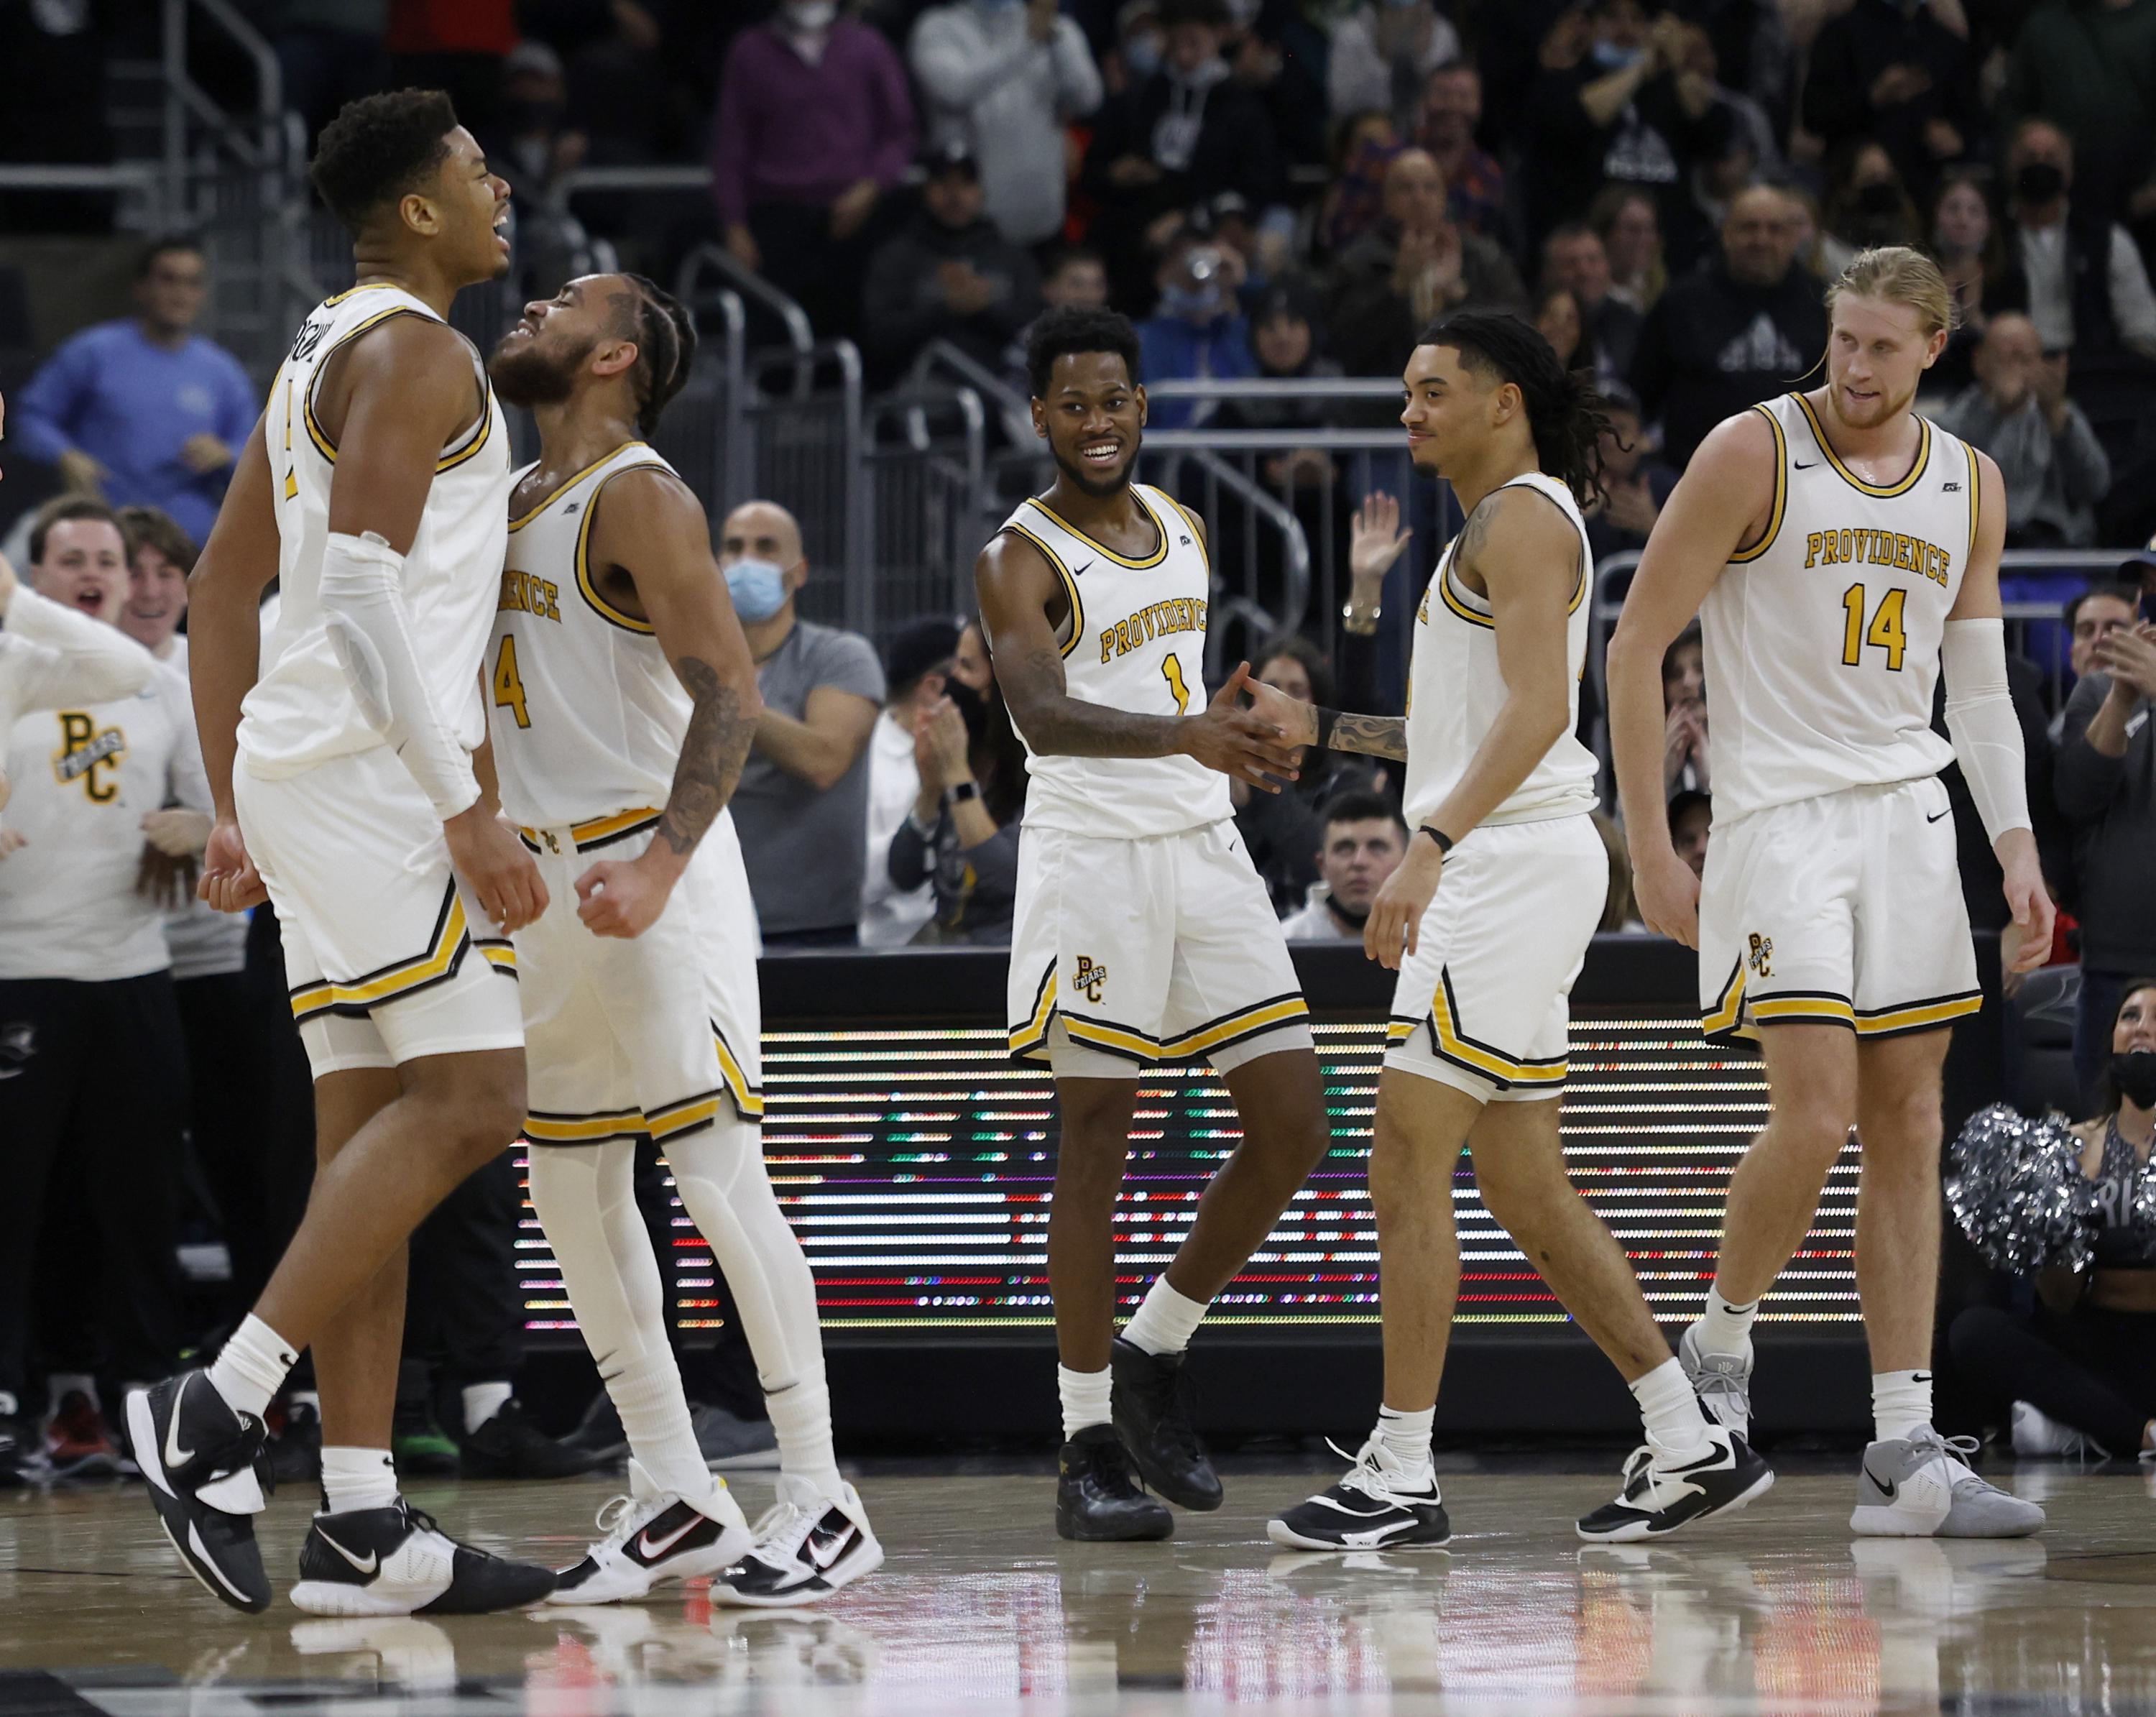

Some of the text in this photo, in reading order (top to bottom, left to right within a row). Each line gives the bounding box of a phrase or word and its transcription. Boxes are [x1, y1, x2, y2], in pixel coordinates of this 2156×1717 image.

[1805, 528, 1950, 589] PROVIDENCE
[1100, 598, 1207, 664] PROVIDENC
[1842, 582, 1907, 671] 14
[494, 634, 532, 729] 4
[1161, 652, 1190, 716] 1
[1074, 967, 1105, 990] FRIARS
